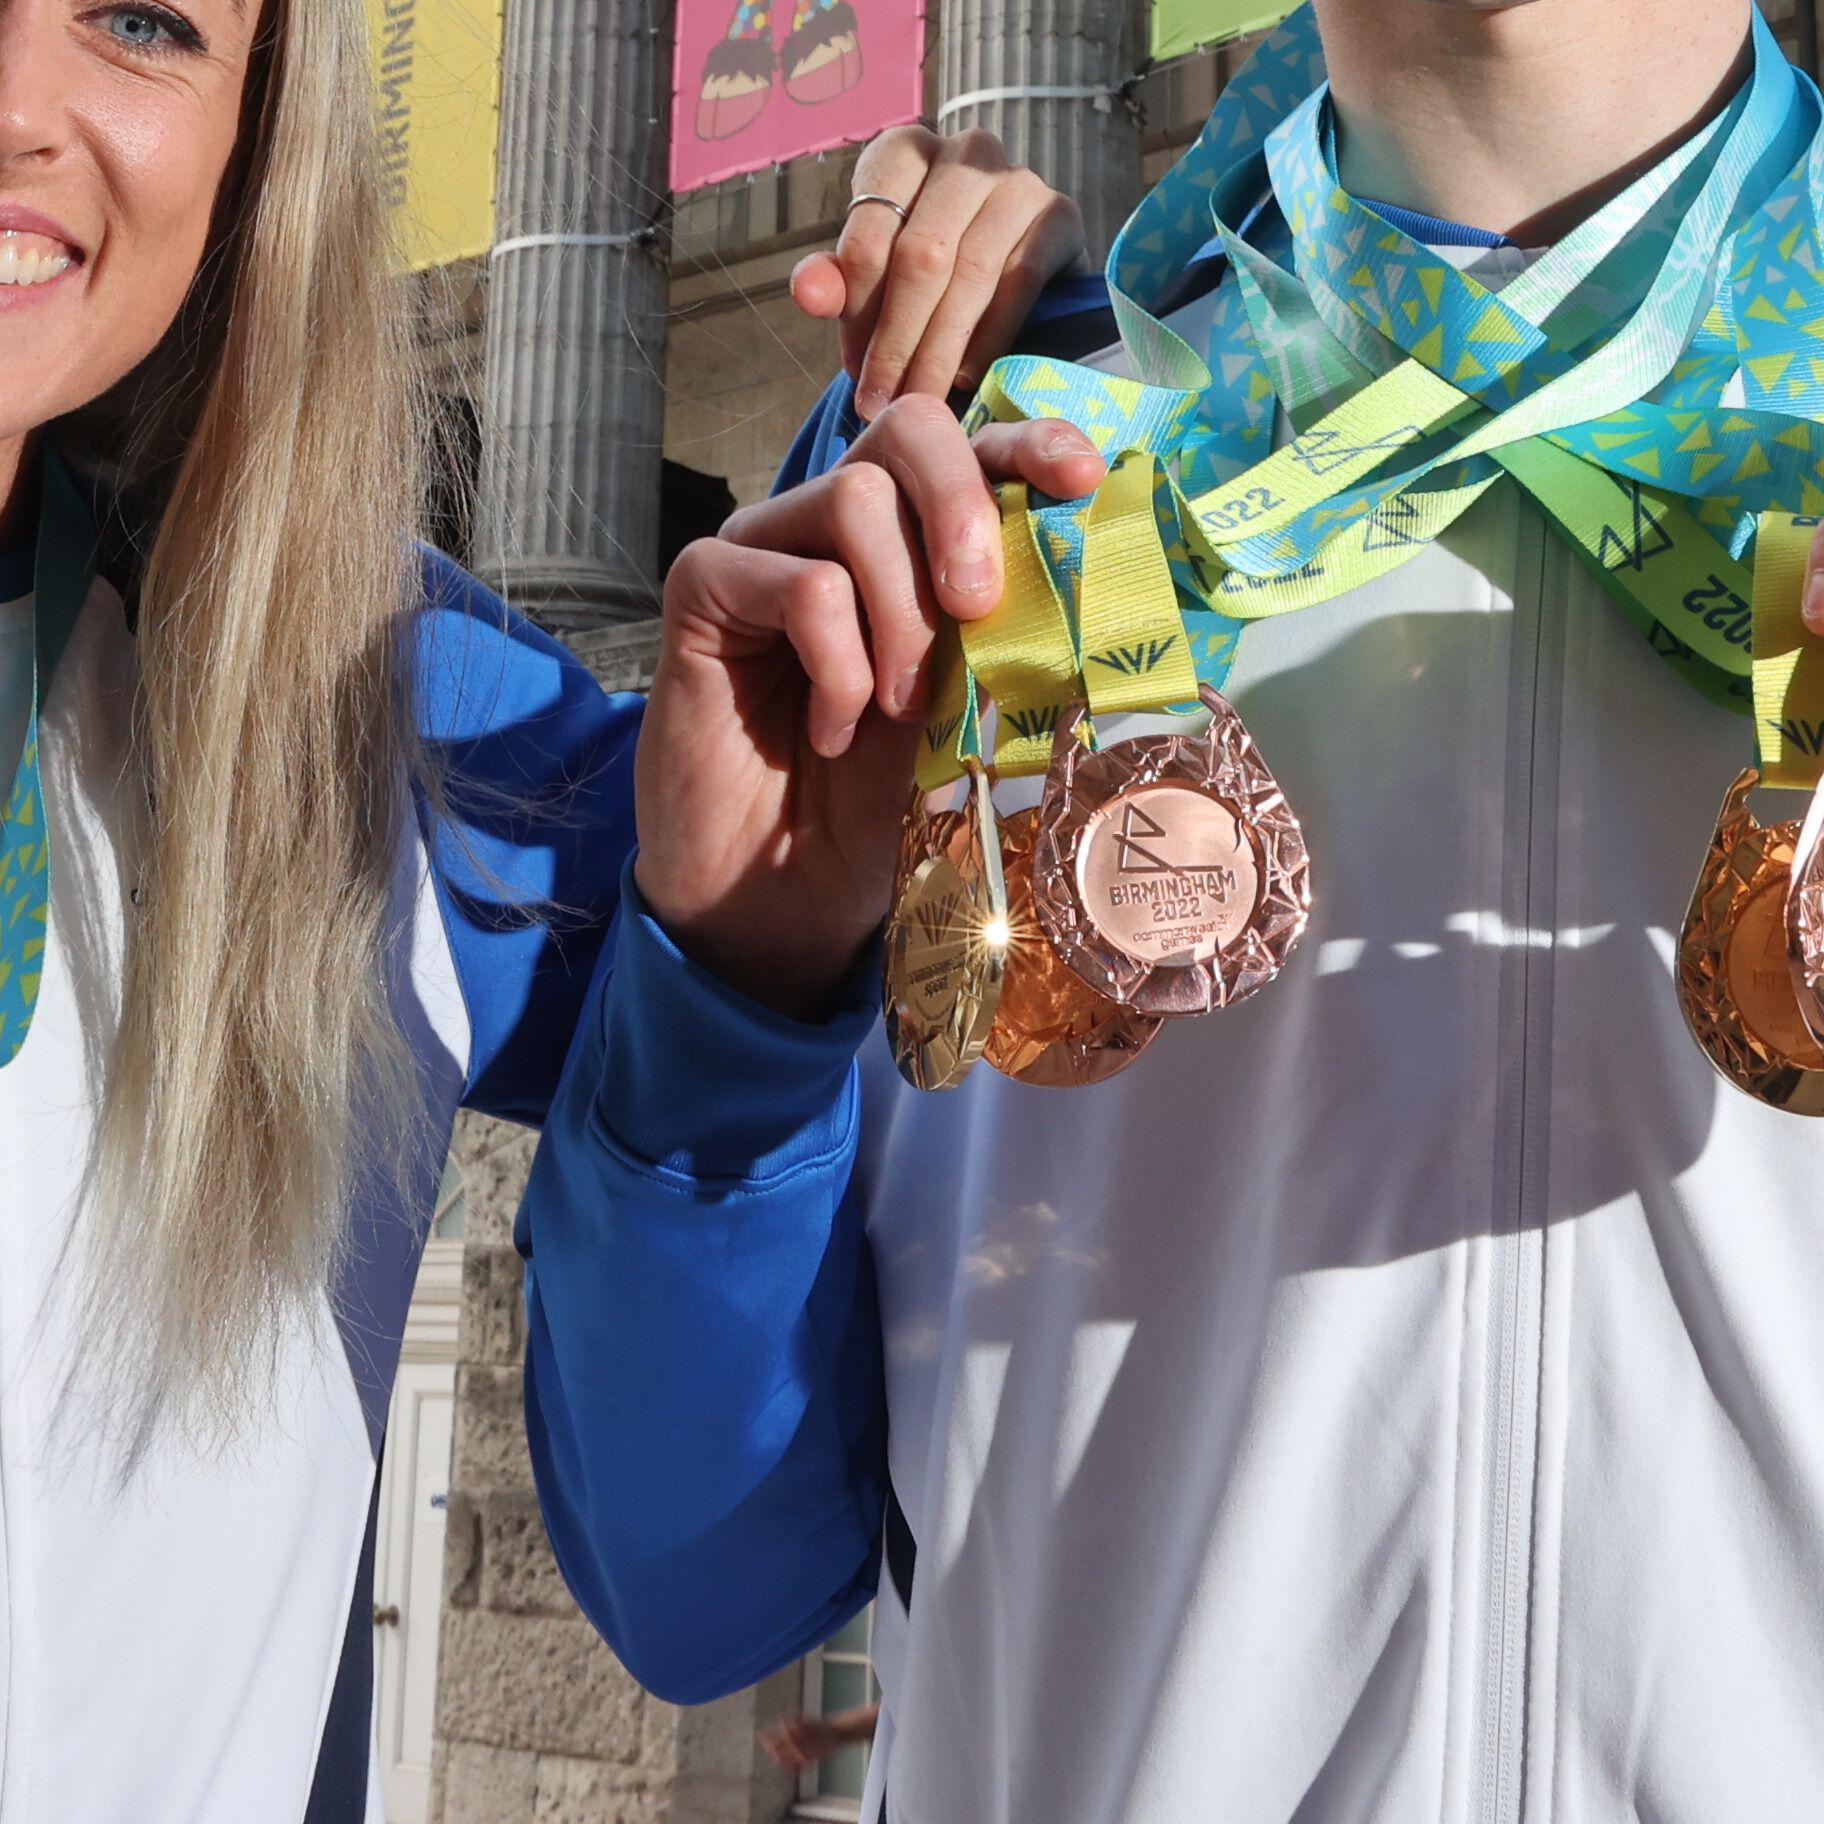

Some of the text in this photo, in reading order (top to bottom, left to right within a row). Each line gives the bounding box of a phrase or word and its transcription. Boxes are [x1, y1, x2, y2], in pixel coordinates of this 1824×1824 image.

[1199, 487, 1286, 534] 022
[1682, 574, 1752, 654] 022
[1109, 870, 1236, 906] BIRMINGHAM
[1151, 897, 1202, 923] 2022
